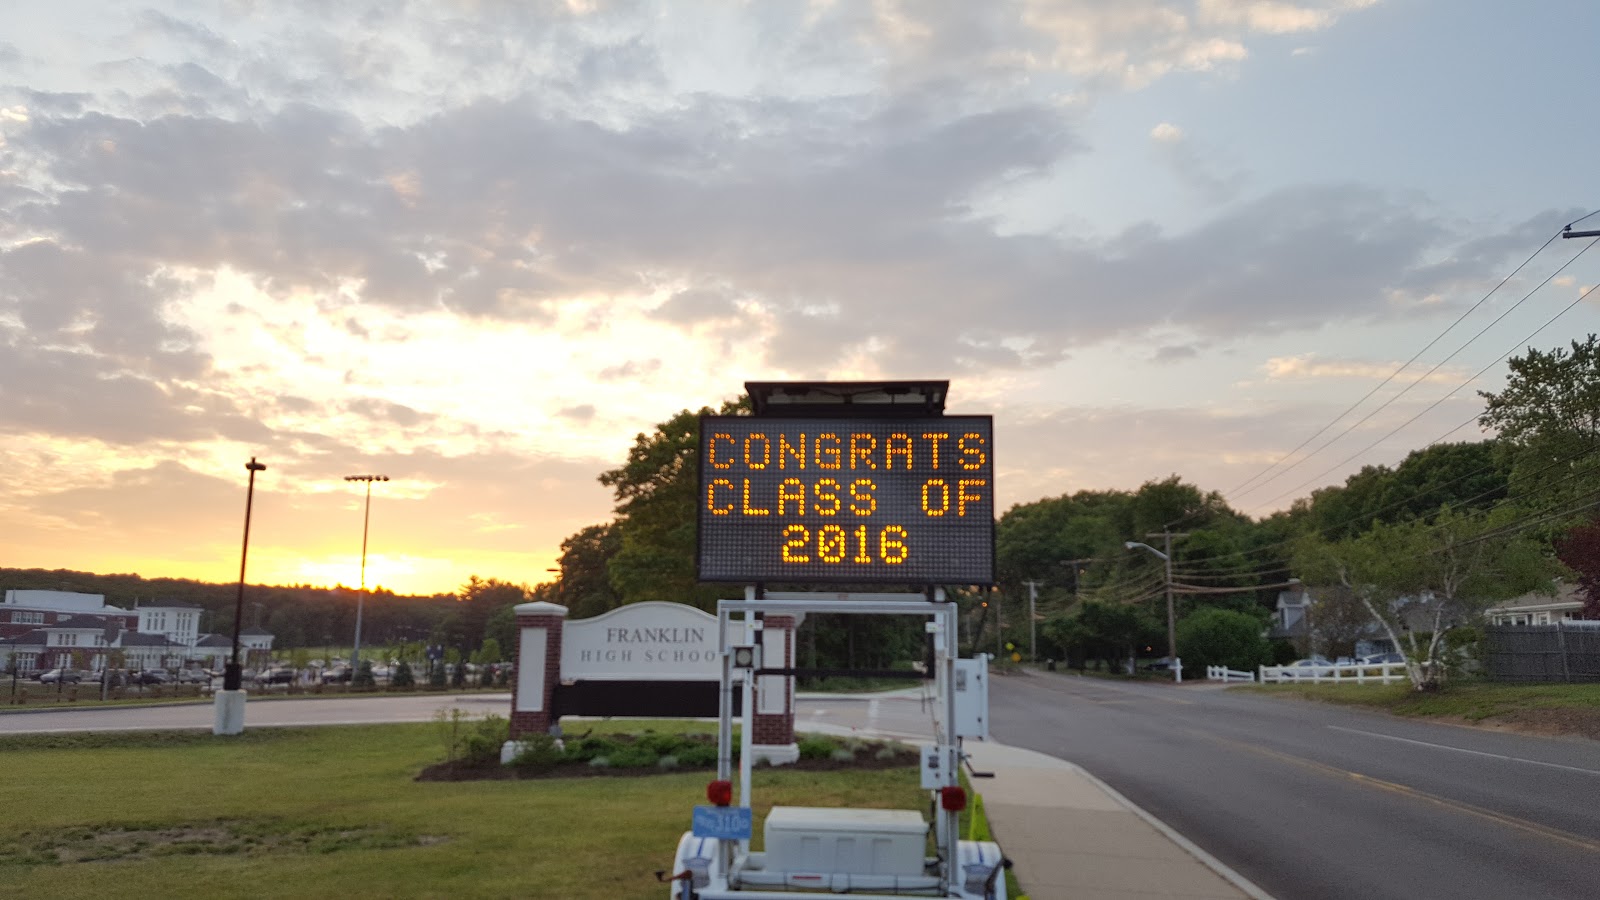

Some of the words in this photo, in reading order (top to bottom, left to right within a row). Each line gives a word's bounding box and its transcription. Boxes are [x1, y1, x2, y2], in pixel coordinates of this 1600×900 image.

[709, 433, 985, 470] CONGRATS
[708, 478, 877, 516] CLASS
[922, 478, 986, 516] OF
[783, 524, 908, 563] 2016
[606, 628, 704, 643] FRANKLIN
[580, 649, 631, 662] HIGH
[645, 649, 716, 662] SCHOO
